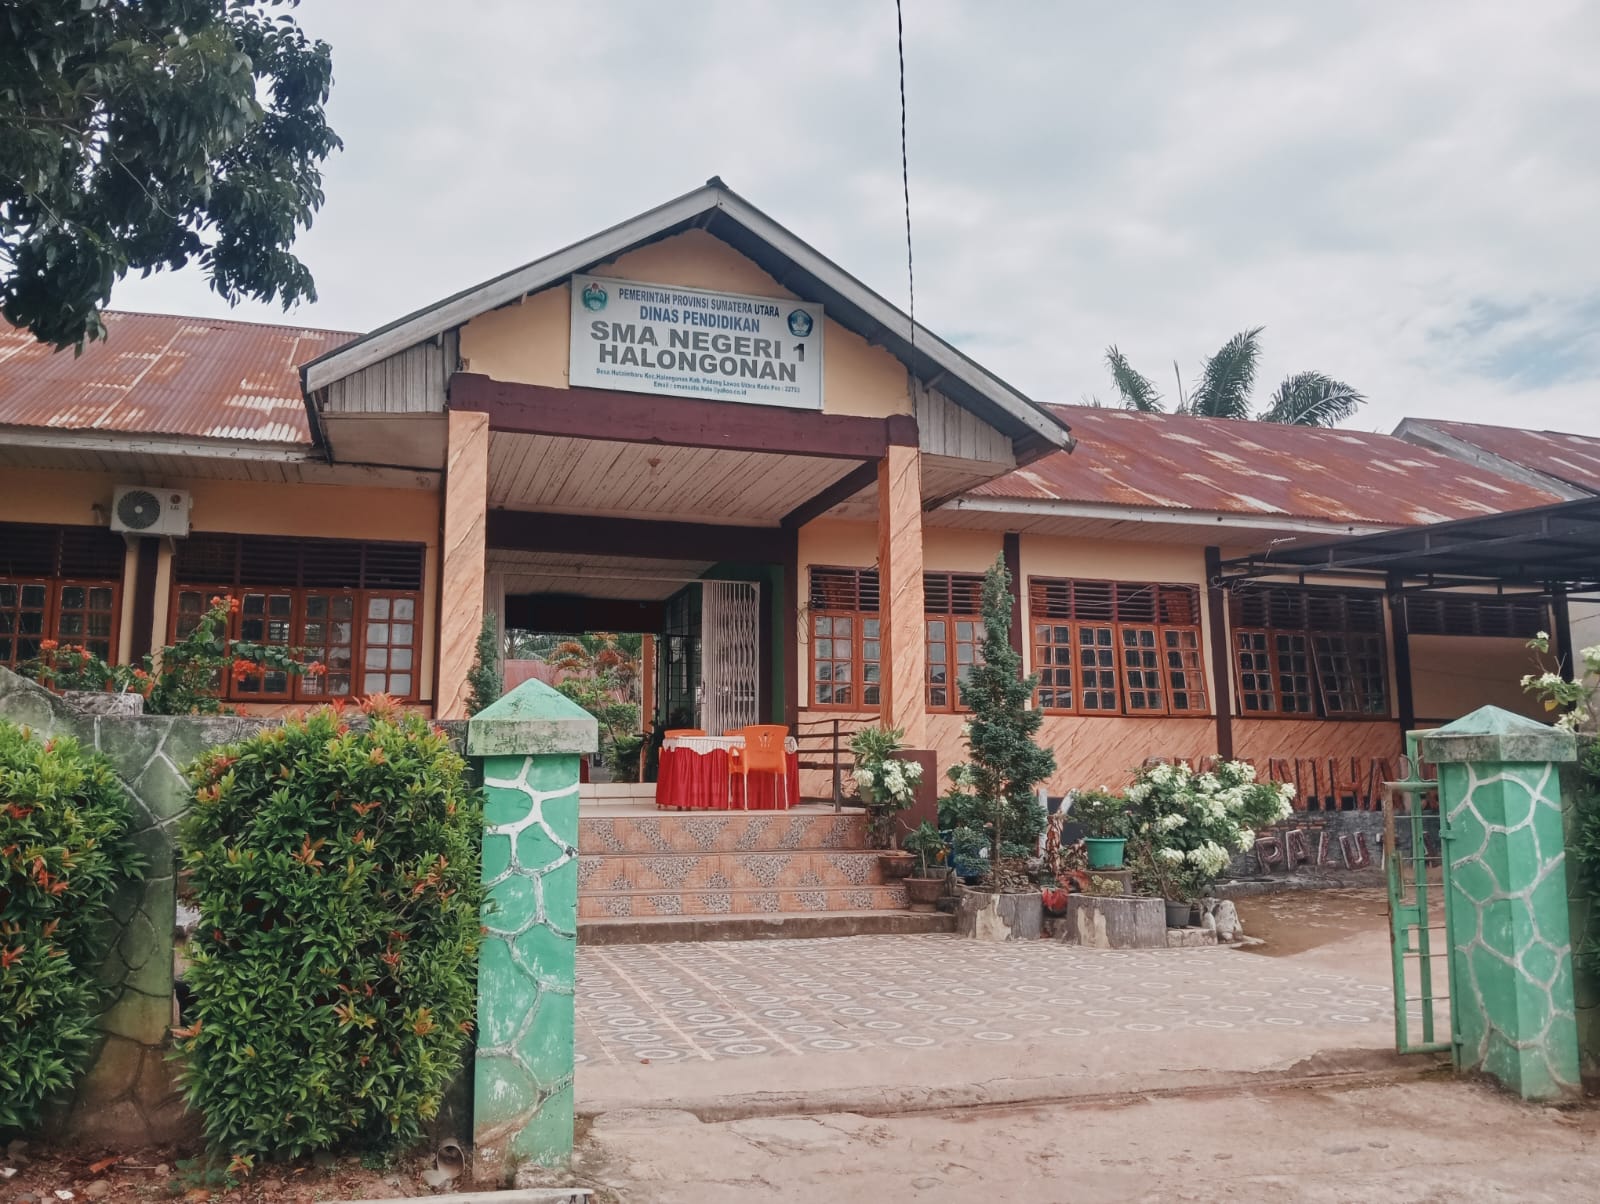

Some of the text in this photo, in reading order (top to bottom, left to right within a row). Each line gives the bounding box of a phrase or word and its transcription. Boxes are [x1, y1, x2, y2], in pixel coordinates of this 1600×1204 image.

[619, 288, 780, 318] PEMERINTAH PROVINSI SUMATERA UTARA
[640, 305, 760, 332] DINAS PENDIDIKAN
[590, 320, 805, 362] SMA NEGERI 1
[599, 343, 796, 382] HALONGONAN
[596, 367, 610, 375] Desa
[702, 377, 722, 387] Padang
[723, 379, 739, 388] Lawas
[740, 381, 756, 389] Utara
